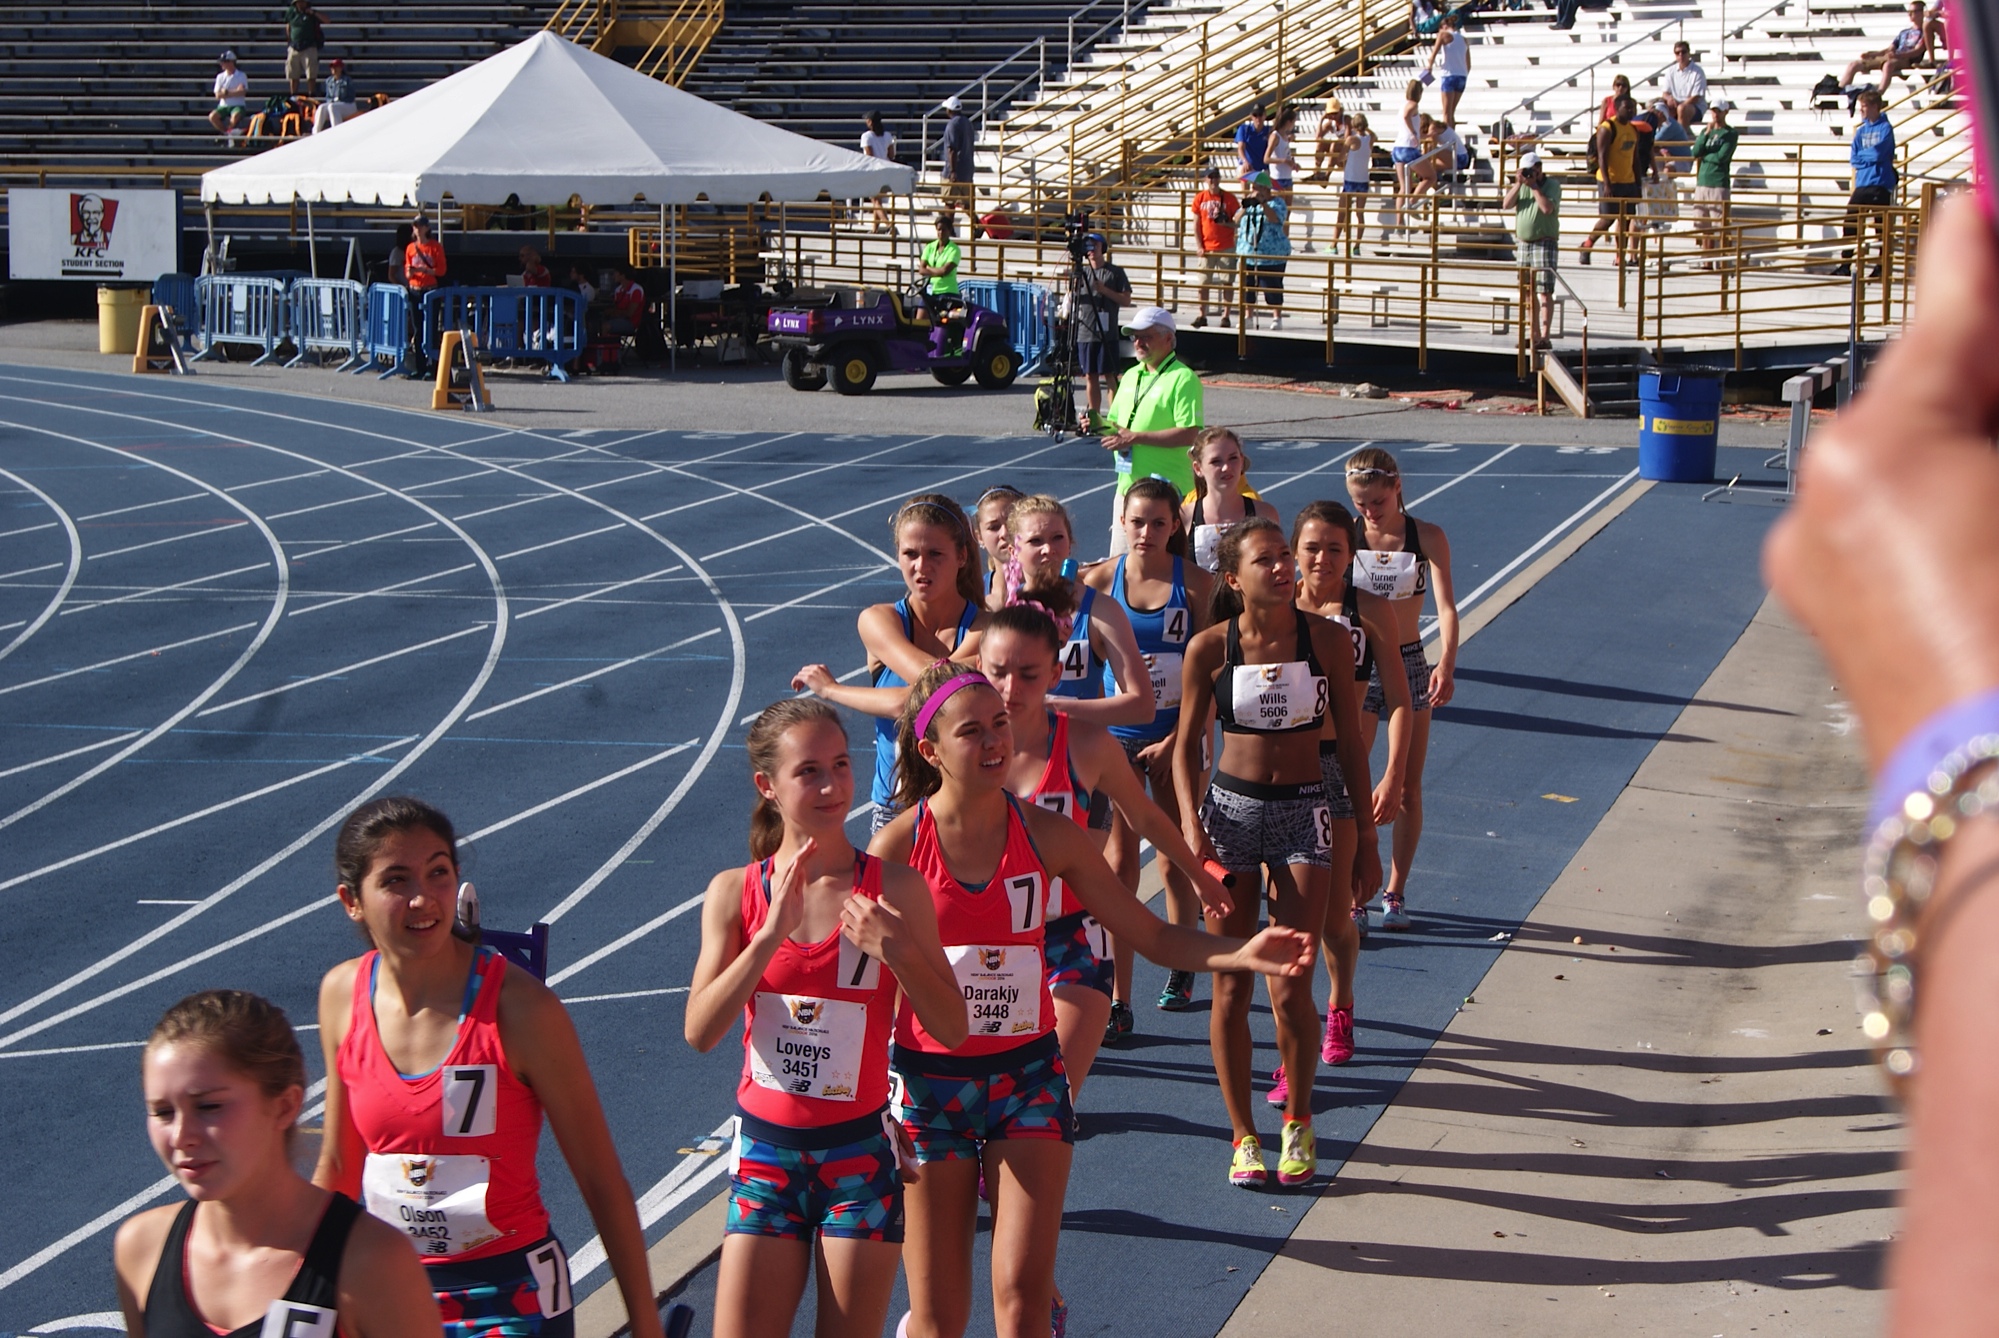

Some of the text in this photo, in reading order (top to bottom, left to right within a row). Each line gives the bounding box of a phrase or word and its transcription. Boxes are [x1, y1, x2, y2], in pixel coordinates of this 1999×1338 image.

[75, 247, 105, 258] KFC
[783, 318, 799, 328] LYNX
[853, 315, 883, 325] LYNX
[1370, 572, 1398, 582] Turner
[1416, 563, 1425, 589] 8
[1373, 583, 1395, 591] 5605
[1167, 610, 1184, 641] 4
[1065, 643, 1084, 677] 4
[1259, 693, 1287, 705] Wills
[1314, 678, 1328, 715] 8
[1260, 706, 1288, 718] 5606
[1299, 784, 1322, 795] NIKE
[1320, 808, 1331, 846] 8
[1012, 877, 1035, 929] 7
[964, 985, 1019, 1003] Darakjy
[798, 1008, 815, 1017] NBN
[973, 1004, 1009, 1019] 3448
[776, 1037, 831, 1060] Loveys
[782, 1059, 818, 1079] 3451
[454, 1069, 486, 1134] 7
[400, 1205, 448, 1222] Olson
[537, 1247, 561, 1313] 7
